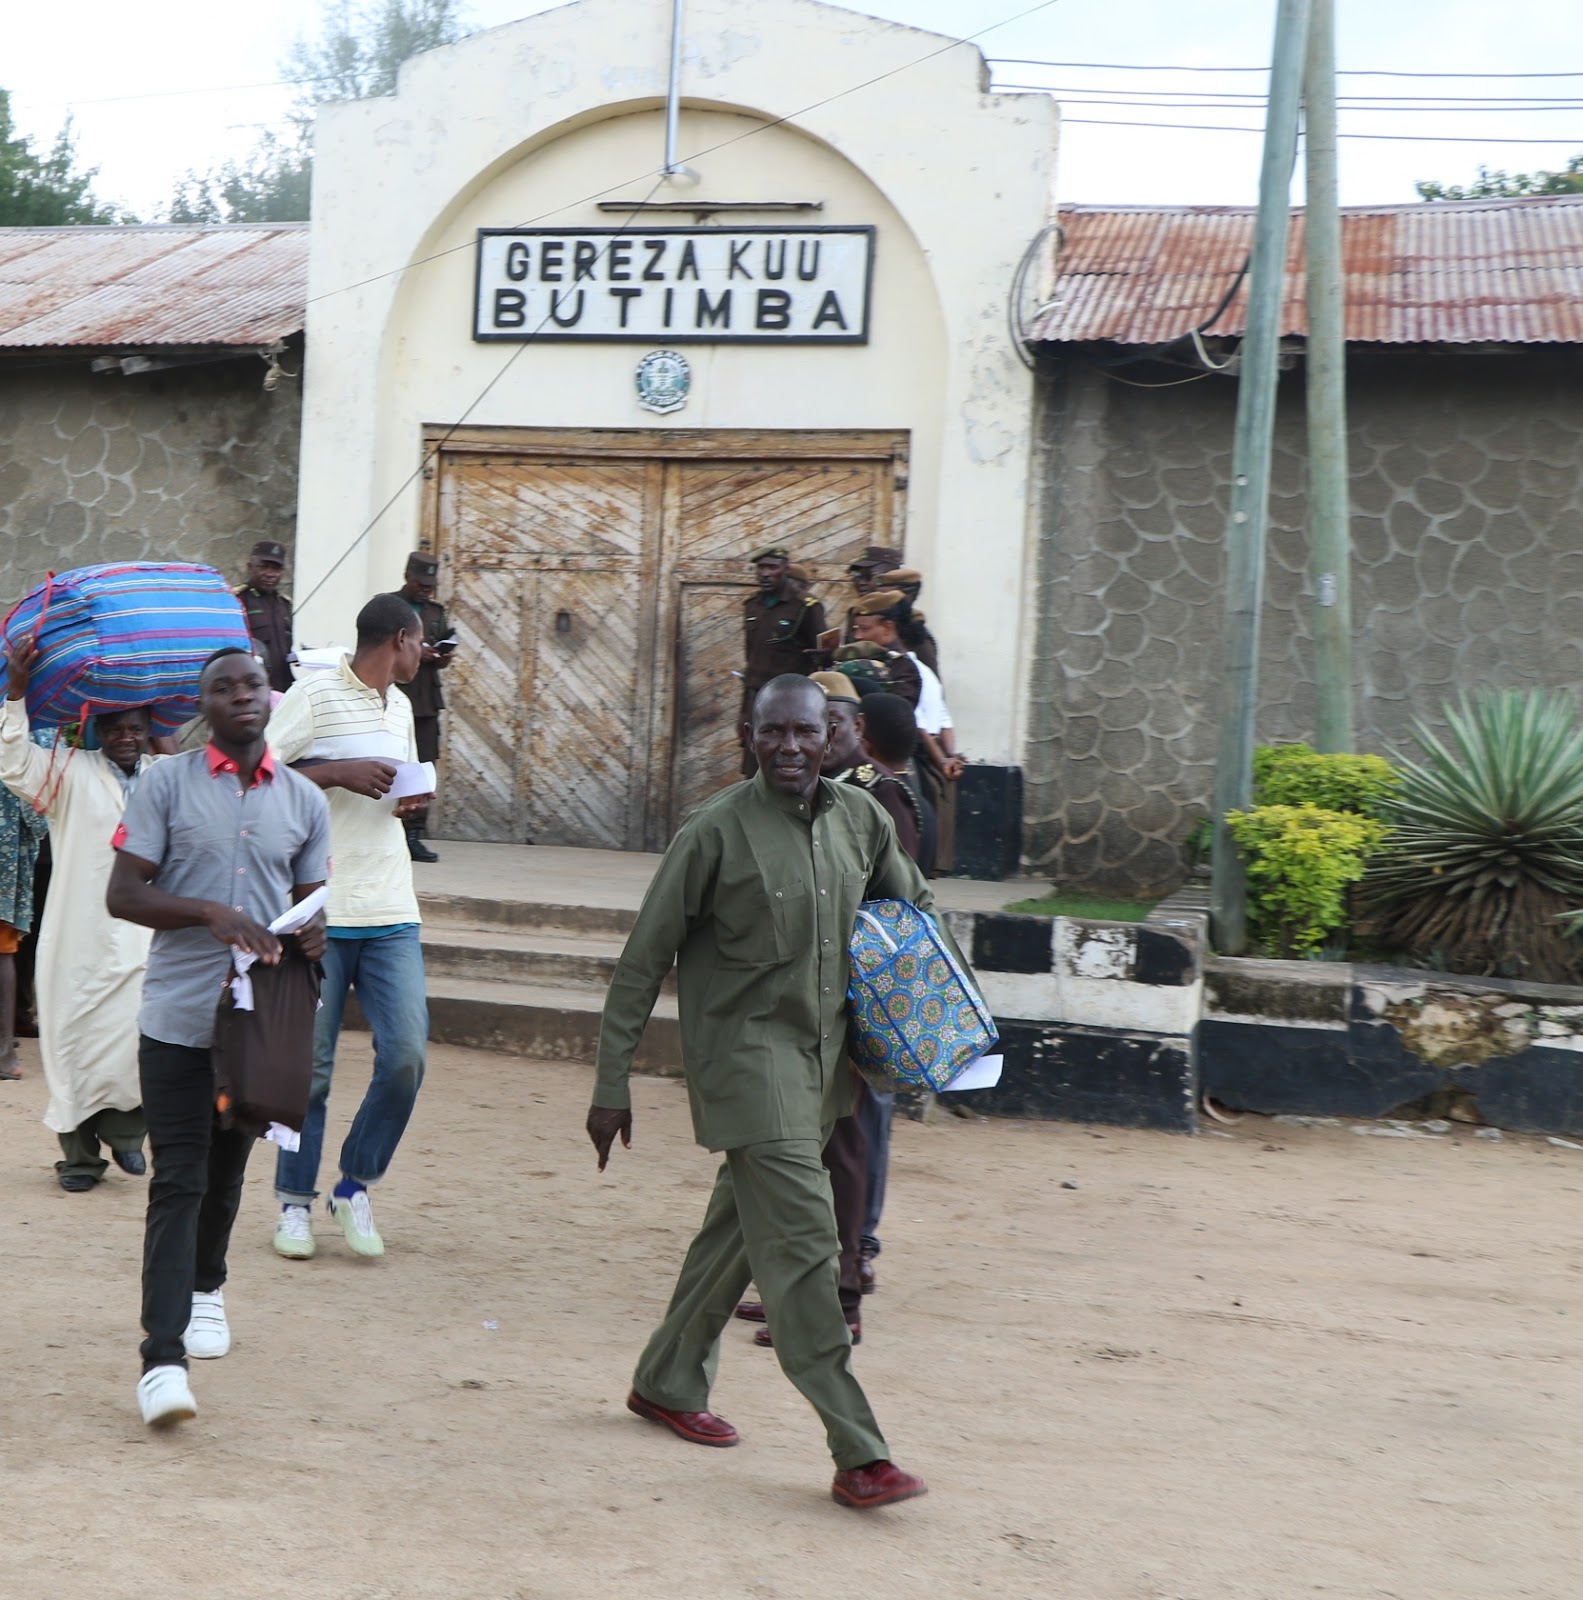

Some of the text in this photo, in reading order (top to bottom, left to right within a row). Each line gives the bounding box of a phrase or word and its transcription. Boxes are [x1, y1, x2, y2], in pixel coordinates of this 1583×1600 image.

[506, 238, 821, 282] GEREZA KUU
[493, 287, 848, 330] BUTIMBA
